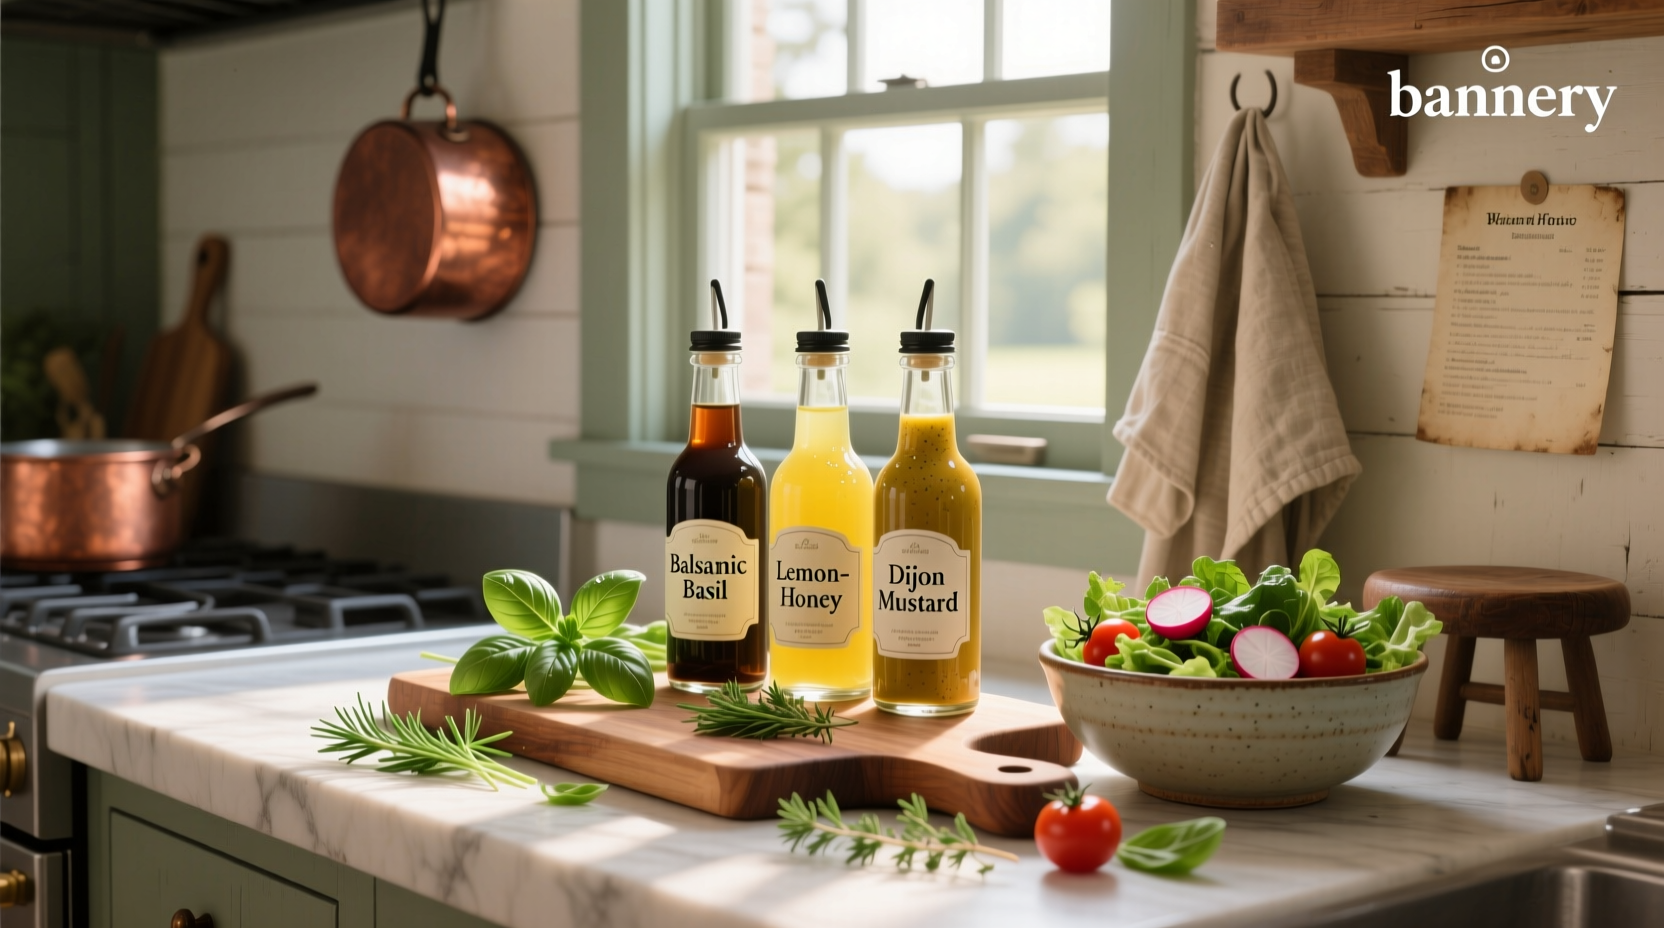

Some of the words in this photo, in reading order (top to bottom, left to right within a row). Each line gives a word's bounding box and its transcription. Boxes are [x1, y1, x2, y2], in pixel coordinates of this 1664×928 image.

[776, 560, 850, 583] Lemon-
[888, 563, 945, 593] Dijon
[683, 579, 728, 600] Basil
[780, 586, 843, 615] Honey
[878, 589, 959, 612] Mustard
